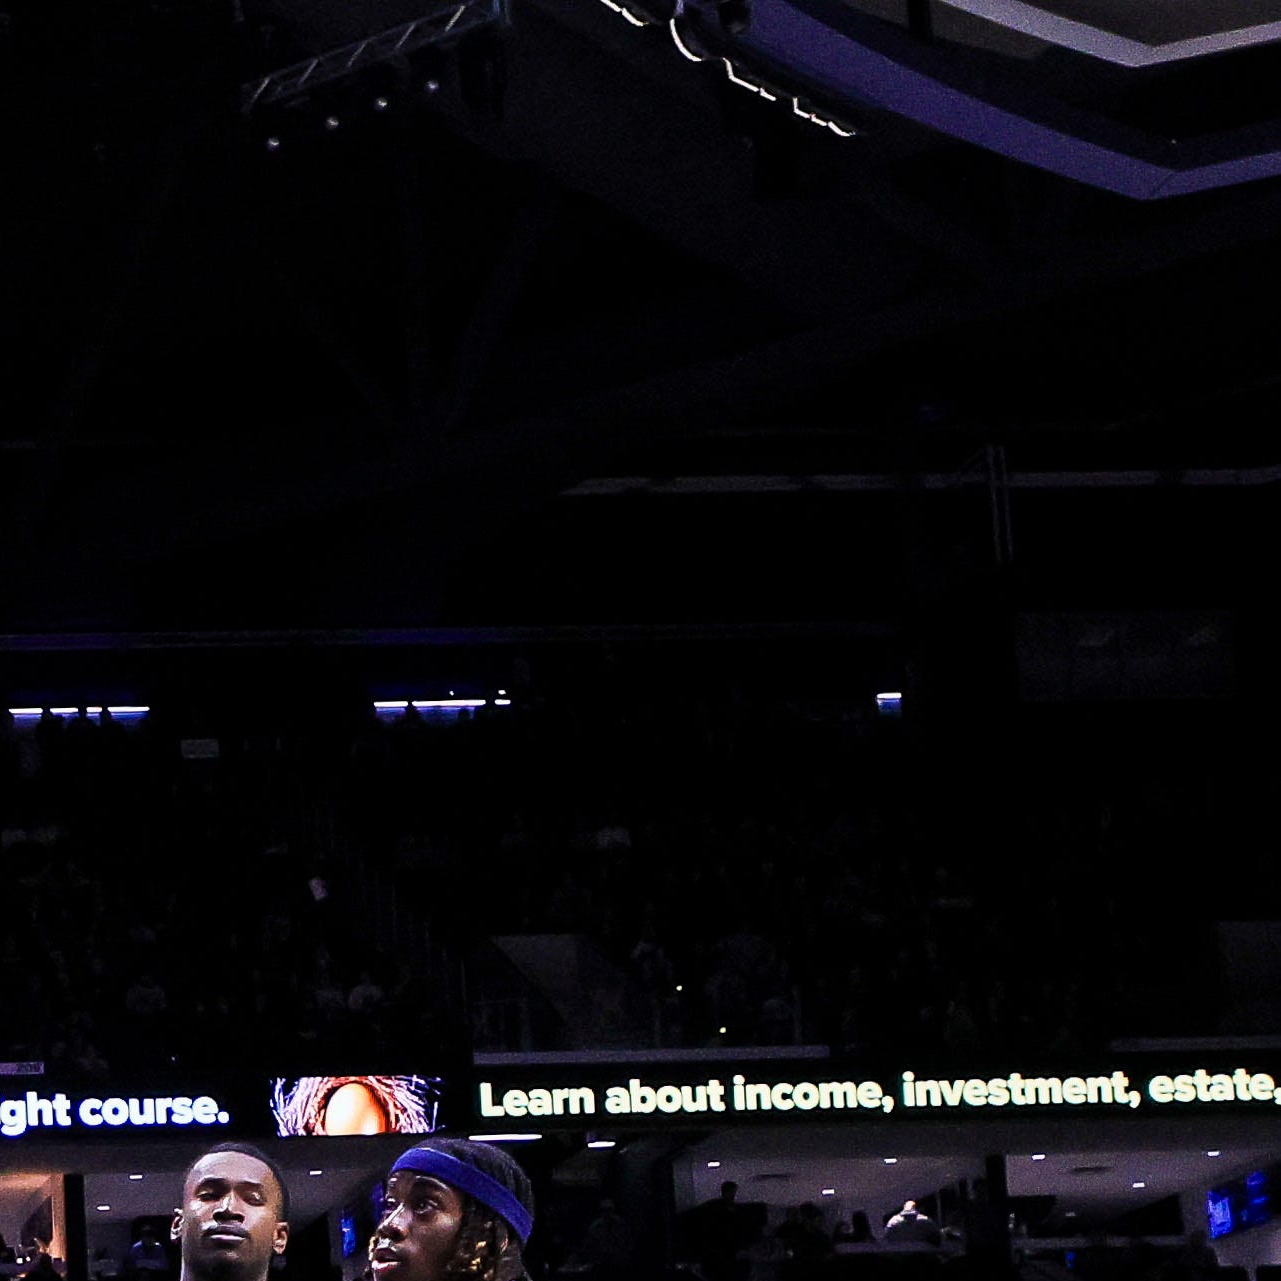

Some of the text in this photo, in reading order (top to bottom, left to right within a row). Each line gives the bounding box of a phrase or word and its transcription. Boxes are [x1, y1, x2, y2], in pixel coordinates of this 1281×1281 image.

[80, 1093, 230, 1126] course.
[480, 1069, 1281, 1117] Learn about income, investment, estate,
